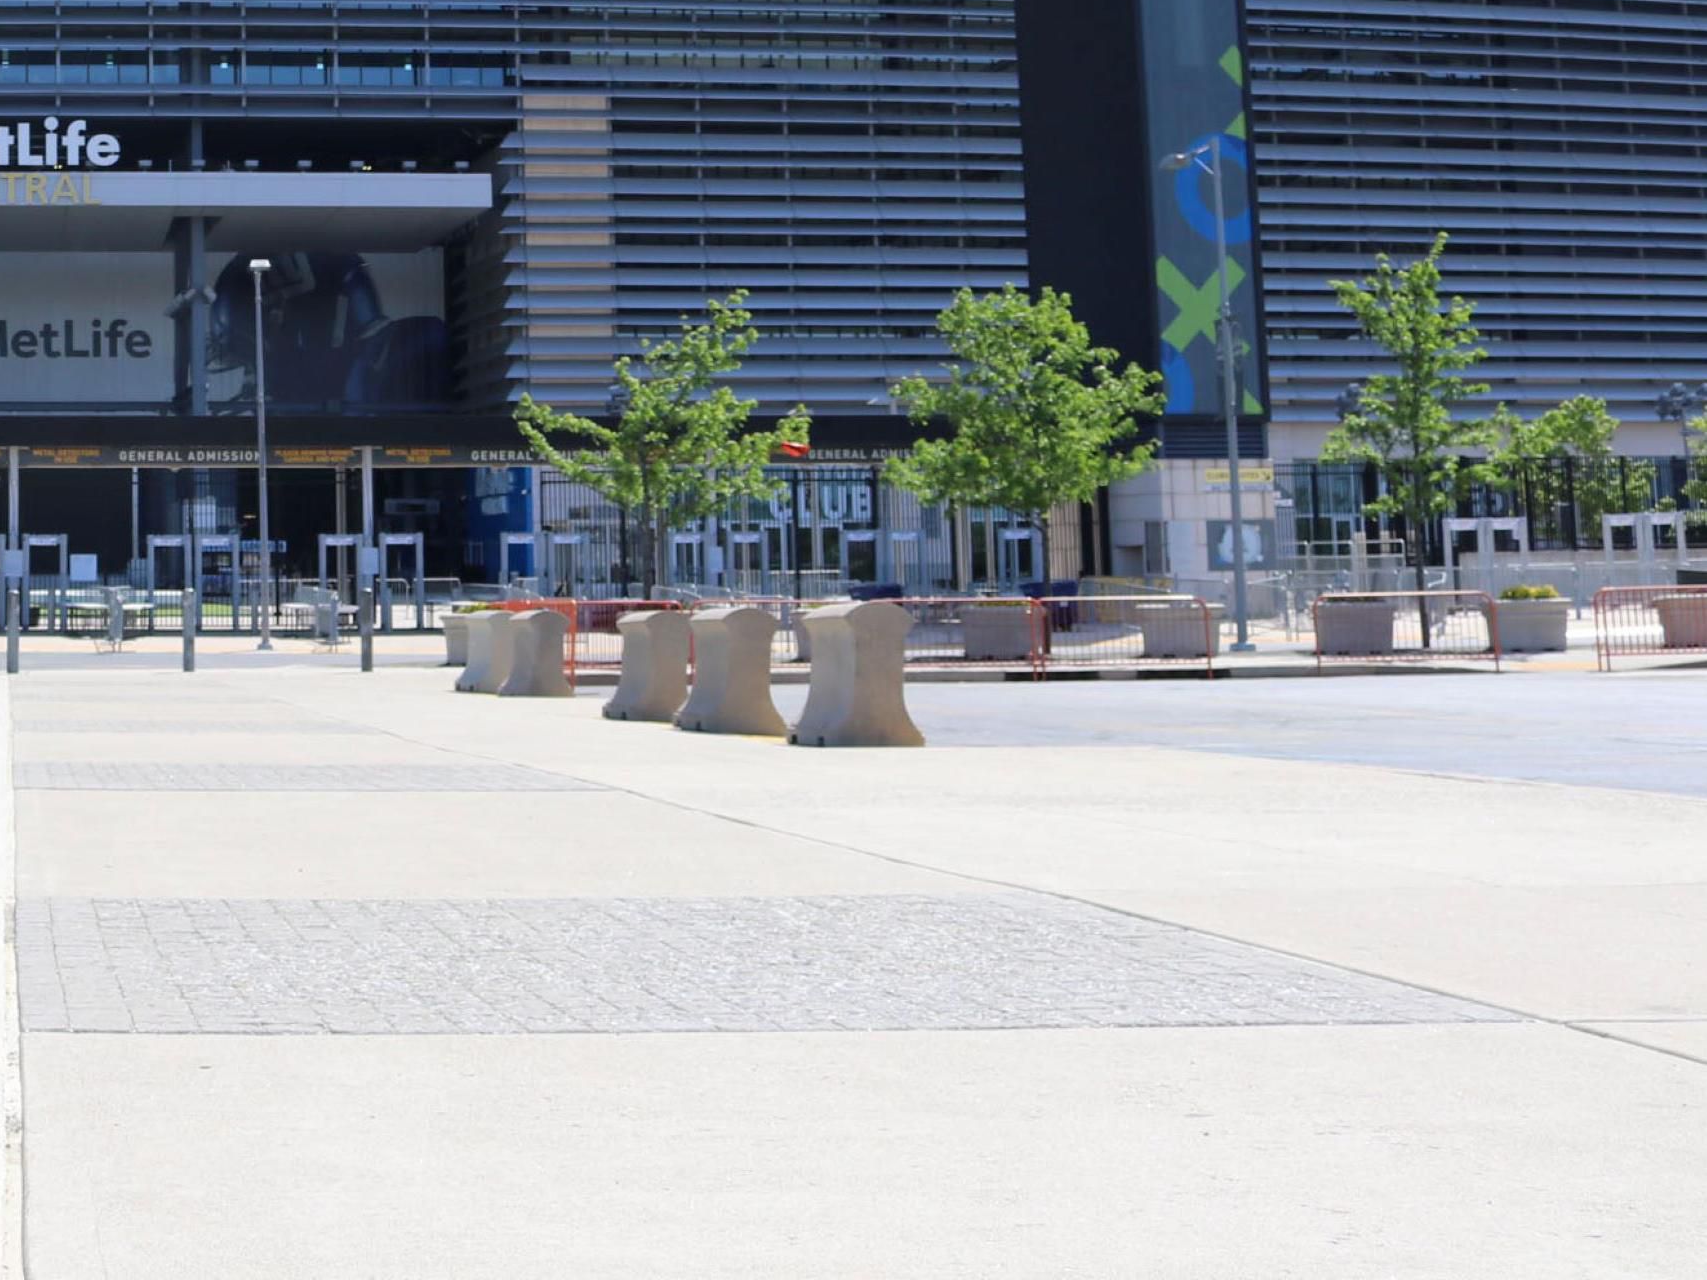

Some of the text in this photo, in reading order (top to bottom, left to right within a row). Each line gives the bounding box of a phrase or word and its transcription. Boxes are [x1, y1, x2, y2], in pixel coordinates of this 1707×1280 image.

[119, 450, 182, 461] GENERAL
[471, 450, 533, 461] GENERAL
[809, 449, 867, 460] GENERAL
